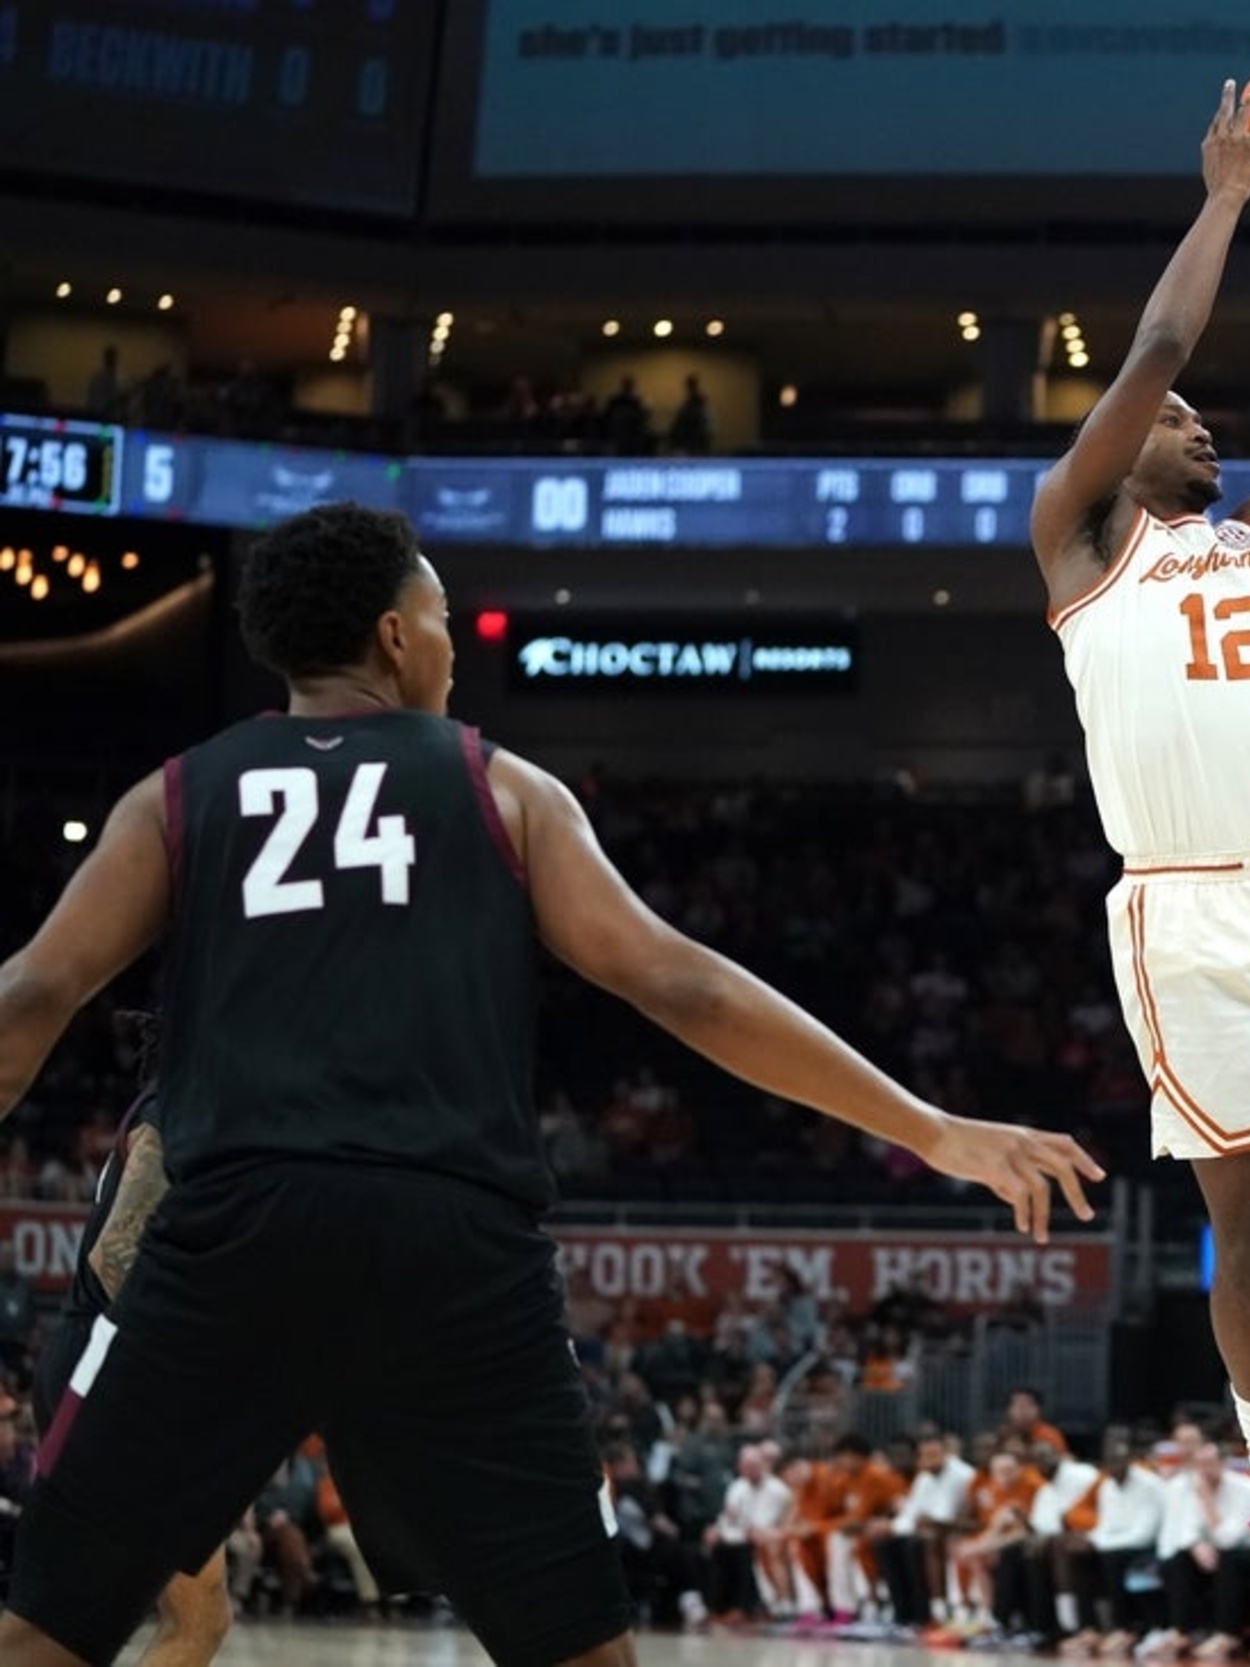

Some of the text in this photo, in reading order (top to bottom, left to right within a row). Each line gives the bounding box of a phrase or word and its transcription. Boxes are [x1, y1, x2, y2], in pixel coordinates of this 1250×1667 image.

[866, 20, 1004, 55] started
[6, 436, 88, 492] 7:56
[144, 443, 175, 503] 5
[543, 636, 737, 677] CHOCTAW
[238, 762, 416, 919] 24
